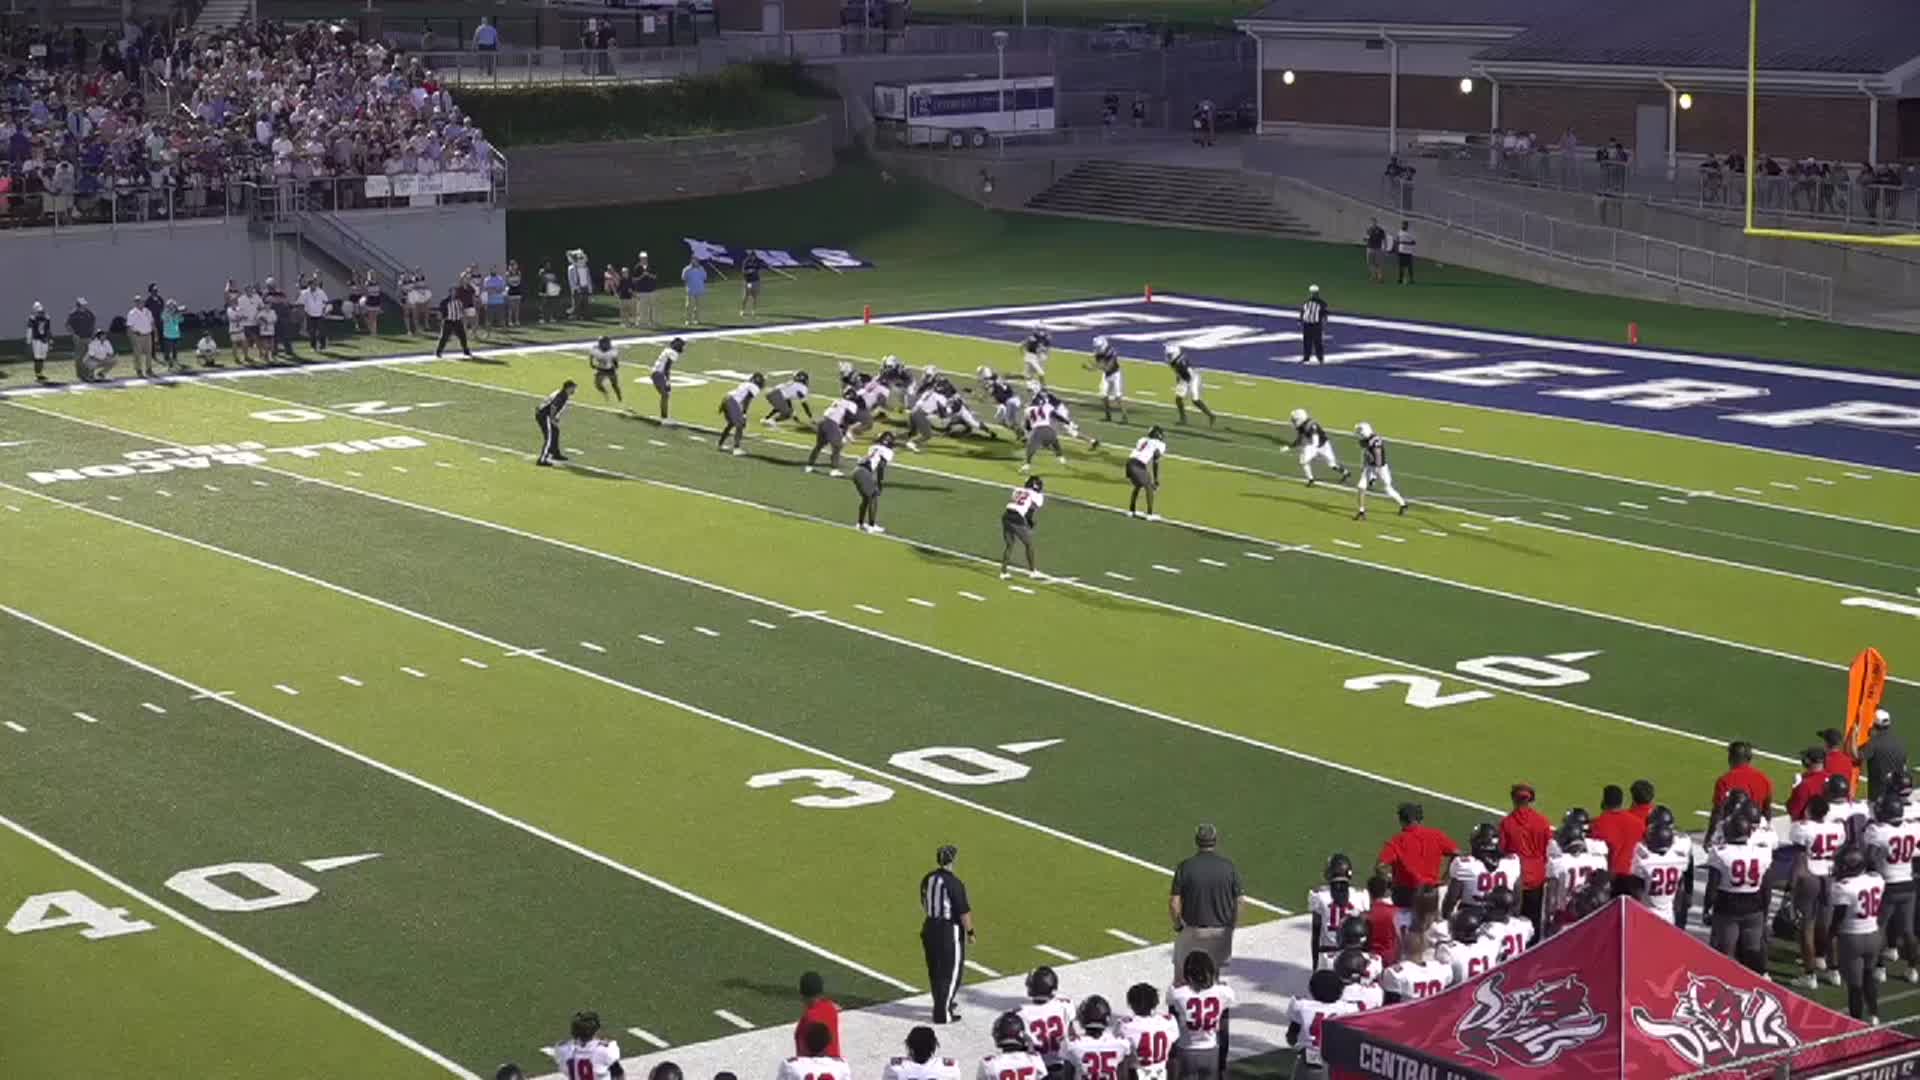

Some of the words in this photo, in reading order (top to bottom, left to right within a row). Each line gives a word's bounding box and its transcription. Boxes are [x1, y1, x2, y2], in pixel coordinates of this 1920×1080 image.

[1344, 655, 1591, 709] 20
[746, 746, 1032, 810] 30
[1812, 834, 1838, 858] 45
[1650, 867, 1679, 896] 28
[1731, 859, 1760, 889] 94
[5, 862, 319, 940] 40
[1857, 888, 1882, 919] 36
[1186, 997, 1221, 1031] 32
[1030, 1015, 1063, 1054] 32
[1138, 1031, 1169, 1066] 40
[1082, 1051, 1117, 1080] 35
